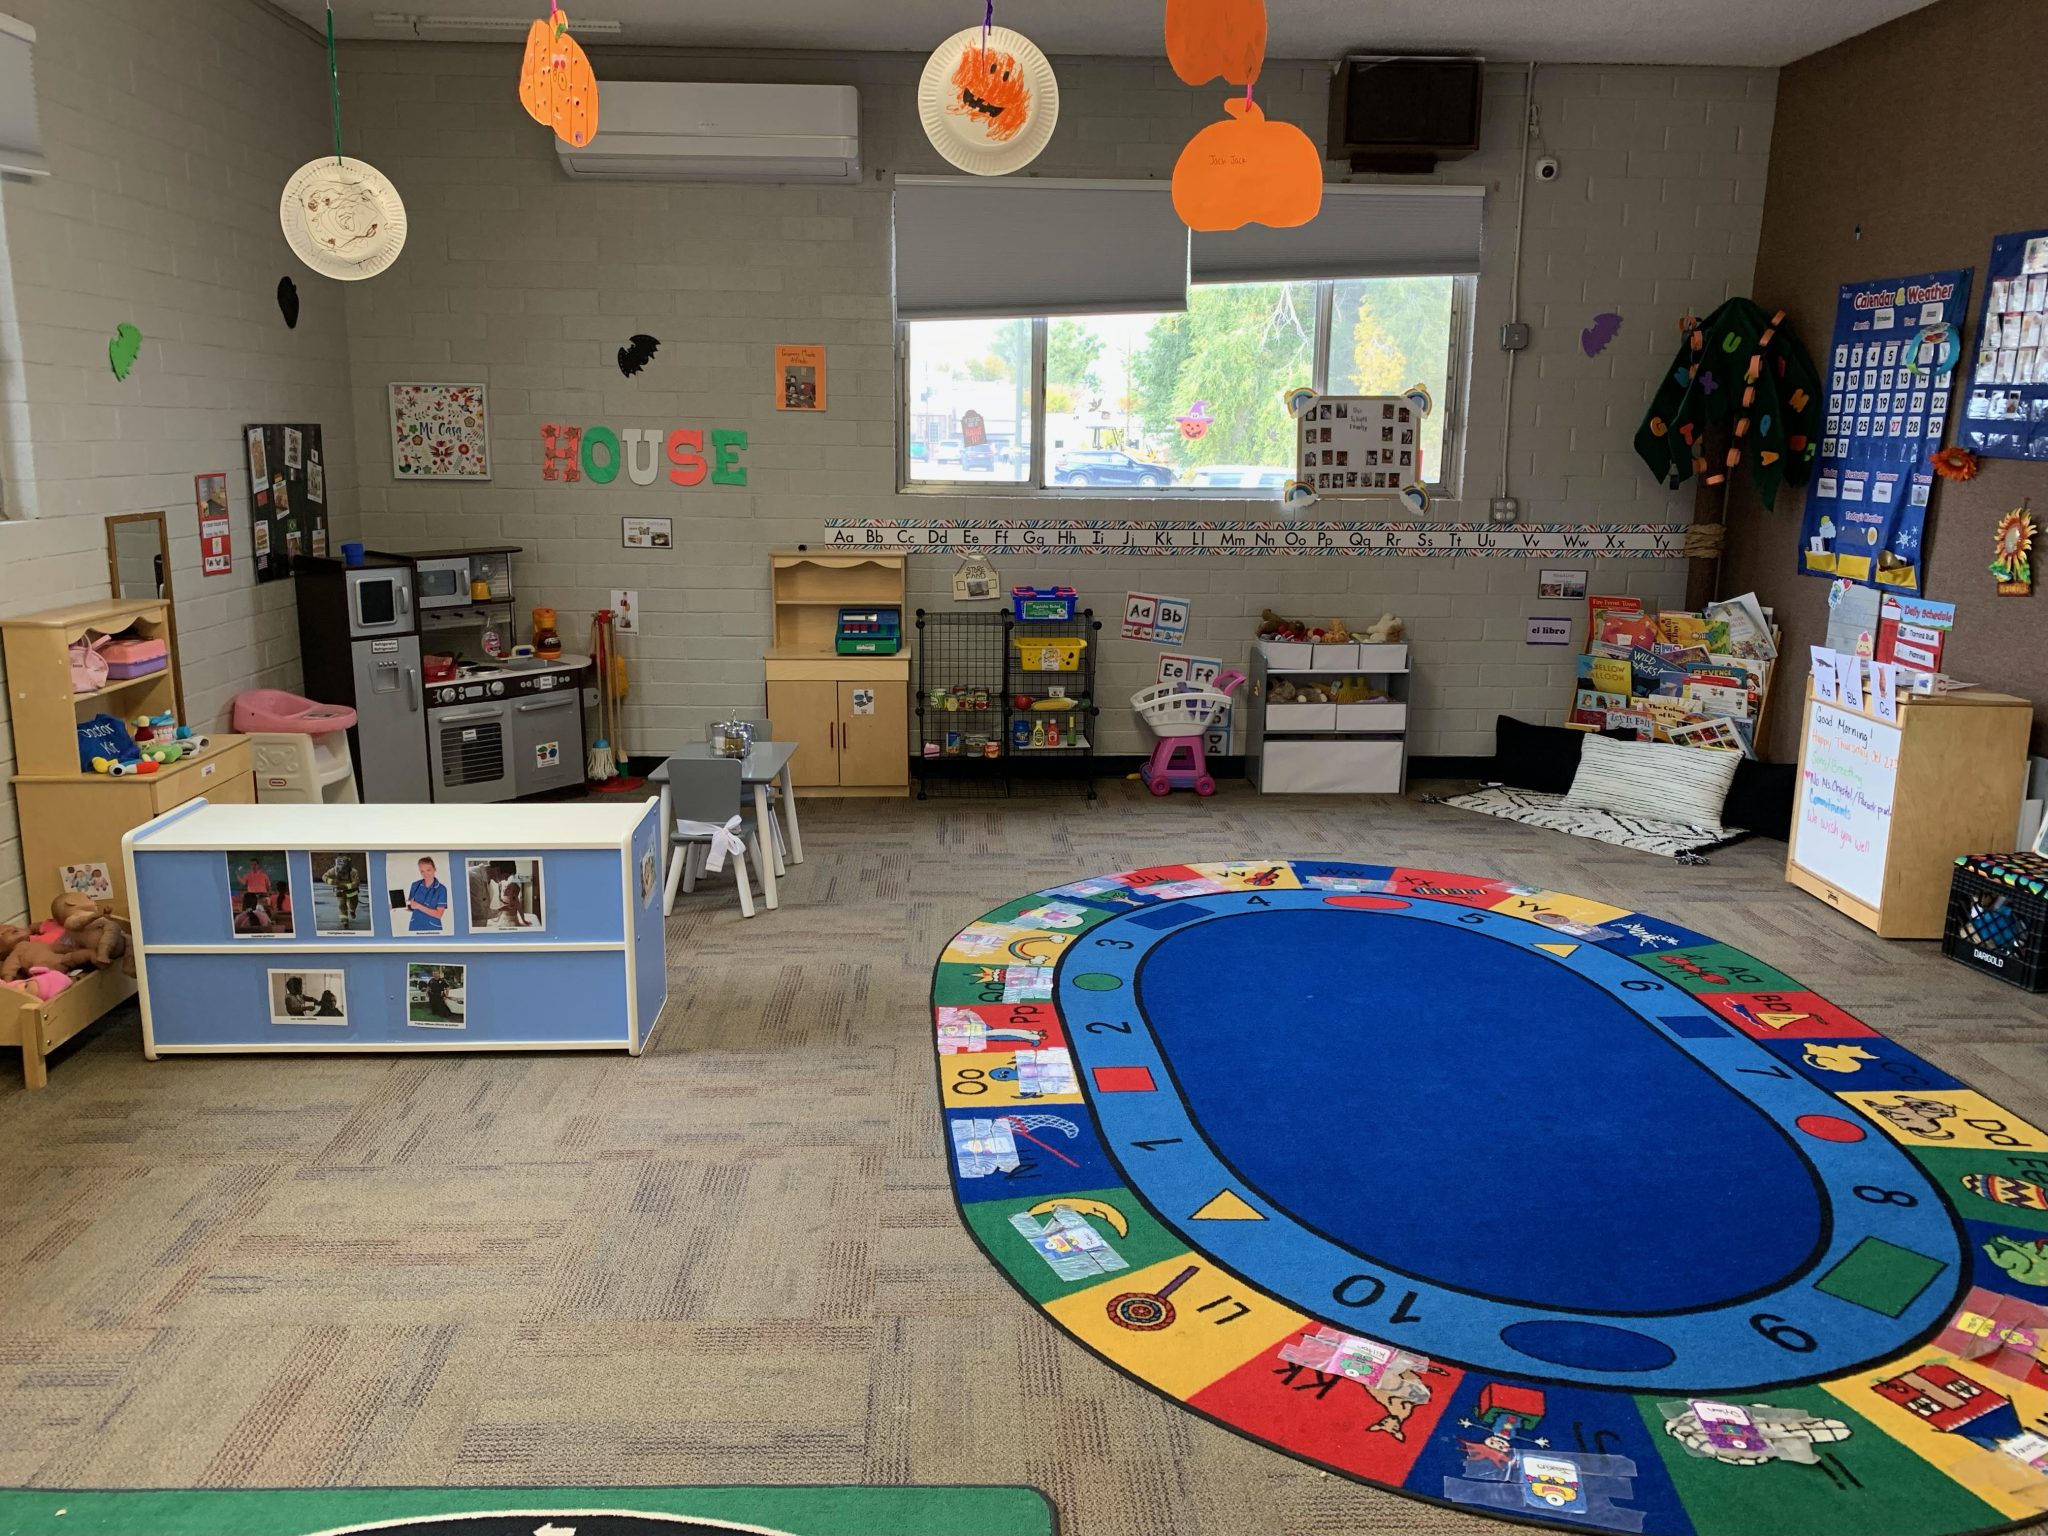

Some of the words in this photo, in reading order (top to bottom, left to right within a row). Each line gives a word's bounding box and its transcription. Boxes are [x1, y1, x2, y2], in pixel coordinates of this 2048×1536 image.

[1854, 290, 1895, 310] Calendar
[1907, 282, 1954, 304] Weather
[1722, 332, 1742, 353] U
[1838, 353, 1844, 363] 2
[1854, 353, 1859, 363] 3
[1871, 352, 1876, 362] 4
[1888, 351, 1894, 361] 5
[1836, 376, 1841, 386] 9
[1850, 375, 1857, 385] 10
[1867, 374, 1874, 384] 11
[1883, 374, 1891, 384] 12
[1900, 373, 1908, 384] 13
[1832, 399, 1839, 408] 16
[1847, 398, 1854, 408] 17
[1863, 399, 1870, 408] 18
[1880, 398, 1888, 408] 19
[1896, 398, 1904, 408] 20
[1913, 397, 1922, 408] 21
[1933, 397, 1944, 408] 22
[420, 422, 434, 436] Mi
[438, 422, 462, 435] Casa
[1828, 420, 1837, 430] 23
[1842, 421, 1851, 431] 24
[1859, 421, 1868, 431] 25
[1875, 421, 1884, 432] 26
[1891, 421, 1900, 432] 27
[1908, 422, 1918, 432] 28
[1930, 422, 1940, 433] 29
[541, 424, 748, 486] HOUSE
[1824, 442, 1834, 452] 30
[1839, 443, 1846, 453] 31
[834, 530, 853, 543] Aa
[866, 530, 884, 543] Bb
[897, 530, 914, 544] Cc
[928, 530, 948, 543] Dd
[964, 530, 979, 544] Ee
[996, 530, 1008, 544] Ff
[1023, 530, 1044, 547] Gg
[1058, 530, 1076, 544] Hh
[1155, 532, 1172, 545] Kk
[1220, 532, 1245, 546] Mm
[1255, 532, 1274, 546] Nn
[1285, 532, 1306, 546] Oo
[1318, 532, 1333, 547] Pp
[1350, 532, 1371, 549] Qq
[1387, 533, 1401, 546] Rr
[1418, 533, 1432, 546] Ss
[1449, 534, 1461, 546] Tt
[1477, 534, 1496, 547] Uu
[1564, 535, 1589, 548] Ww
[1606, 535, 1625, 548] Xx
[1654, 536, 1670, 550] Yy
[1130, 604, 1151, 618] Aa
[1162, 608, 1182, 623] Bb
[1904, 605, 1920, 618] Daily
[1922, 608, 1952, 622] Schedule
[1634, 651, 1656, 665] WILD
[1163, 663, 1183, 678] Ee
[1196, 668, 1214, 683] Ff
[1822, 684, 1830, 697] Aa
[1847, 692, 1857, 705] Bb
[1880, 702, 1890, 716] Cc
[1636, 717, 1650, 727] Fall
[1816, 706, 1832, 726] Good
[1812, 728, 1831, 752] Happy
[99, 742, 120, 756] Kit
[1810, 773, 1819, 787] No
[1808, 808, 1818, 824] We
[1820, 818, 1838, 836] wish
[1841, 830, 1852, 848] you
[1126, 873, 1164, 884] Uu
[1247, 896, 1271, 906] 4
[1457, 913, 1491, 924] 5
[1095, 938, 1134, 950] 3
[1974, 949, 2004, 968] DARIGOLD
[1719, 965, 1764, 984] Aa
[1620, 980, 1665, 992] 6
[1753, 995, 1793, 1012] Bb
[1010, 1005, 1045, 1025] Pp
[1086, 1022, 1132, 1034] 2
[1736, 1066, 1793, 1080] 7
[1881, 1059, 1930, 1086] Cc
[952, 1068, 988, 1095] Oo
[1964, 1119, 2032, 1146] Dd
[1130, 1138, 1183, 1150] 1
[1852, 1186, 1918, 1208] 8
[1332, 1274, 1421, 1324] 10
[1749, 1313, 1818, 1353] 9
